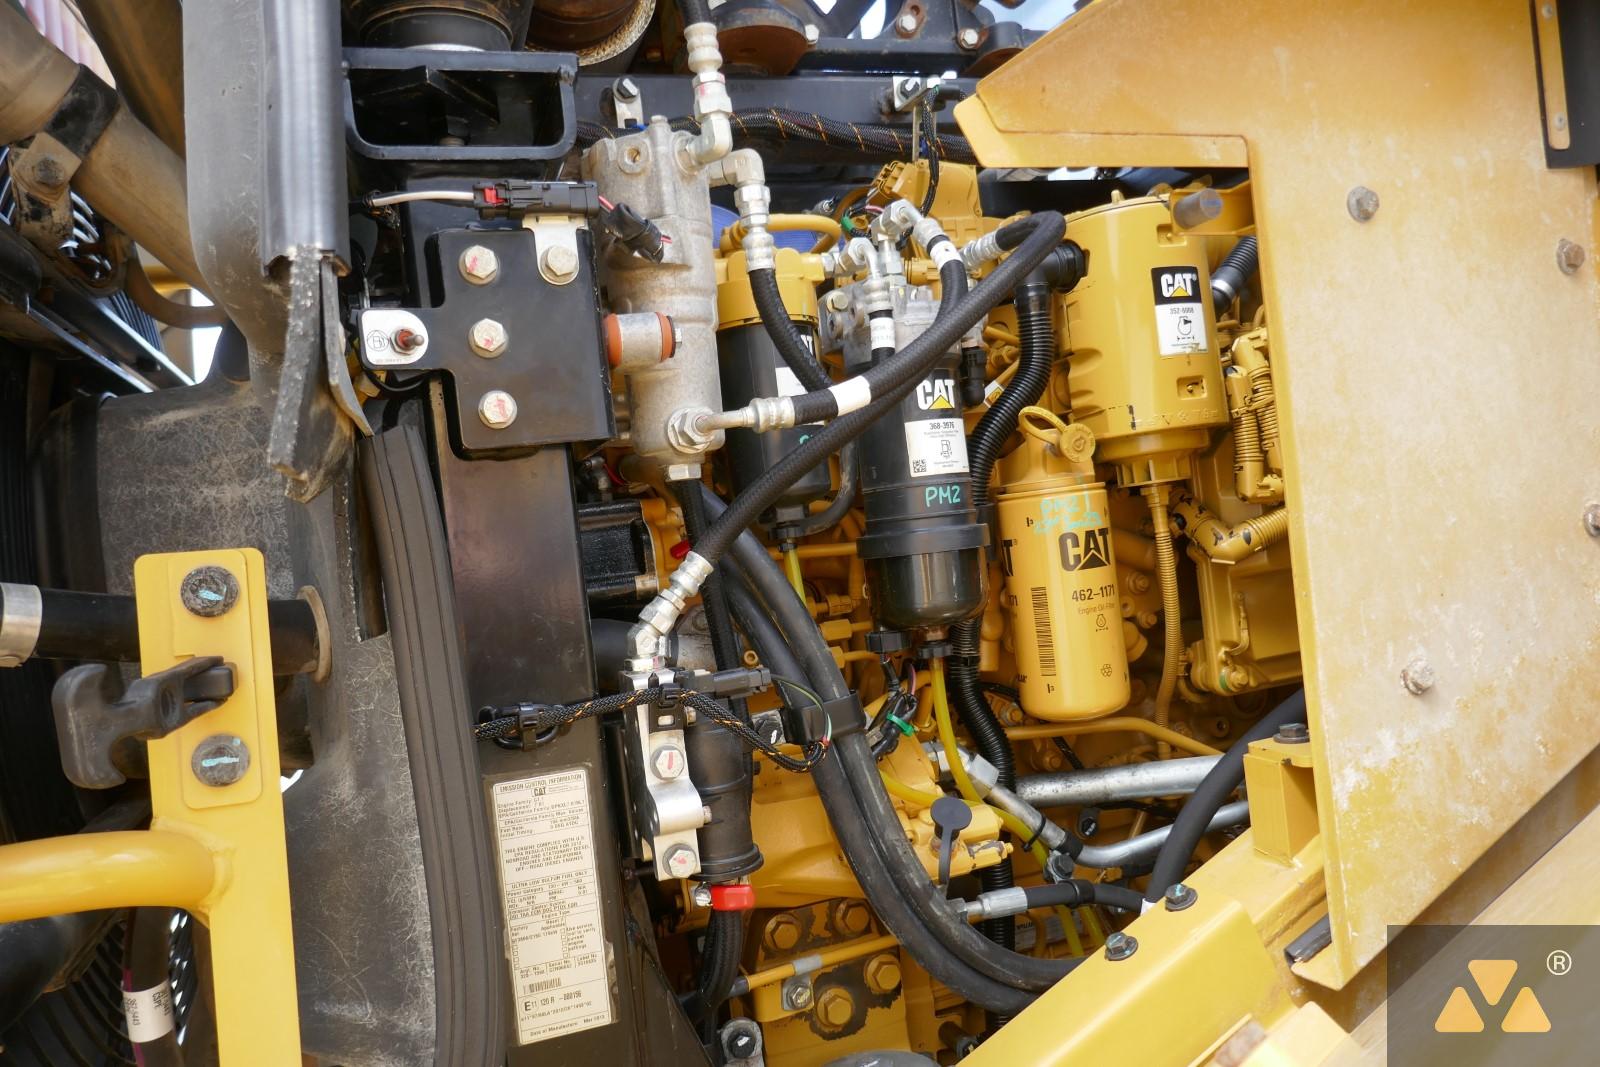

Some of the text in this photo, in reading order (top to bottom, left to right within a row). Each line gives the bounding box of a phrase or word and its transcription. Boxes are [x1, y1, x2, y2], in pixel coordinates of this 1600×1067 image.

[1161, 273, 1192, 297] CAT
[916, 379, 956, 410] CAT
[925, 486, 961, 508] PM2
[1059, 528, 1111, 572] CAT
[1072, 584, 1115, 602] 462-1171
